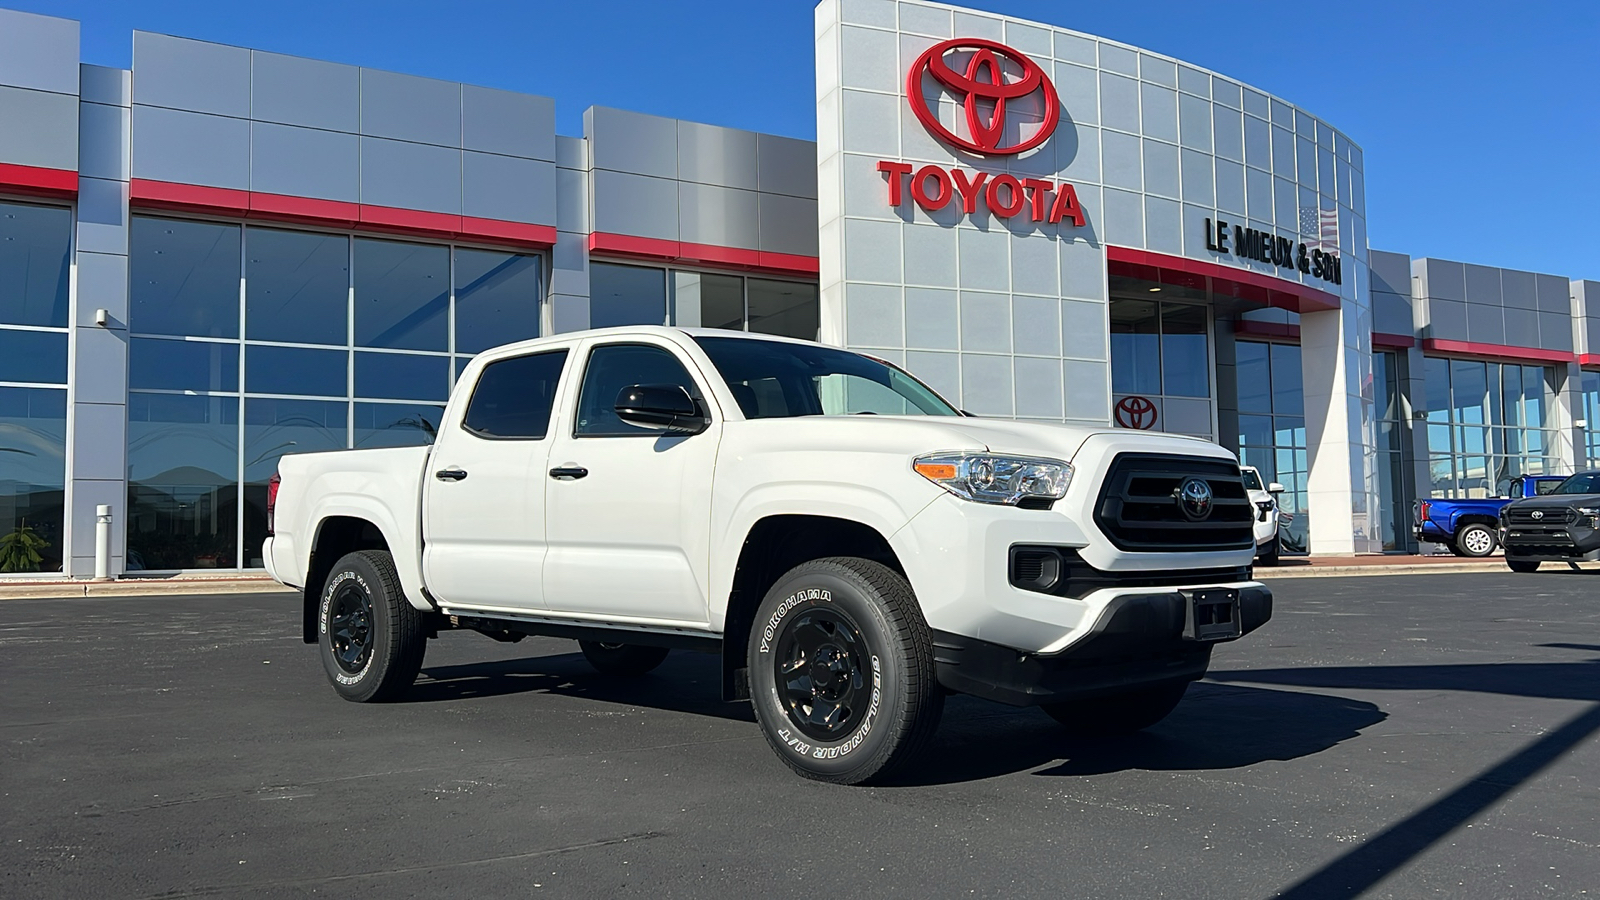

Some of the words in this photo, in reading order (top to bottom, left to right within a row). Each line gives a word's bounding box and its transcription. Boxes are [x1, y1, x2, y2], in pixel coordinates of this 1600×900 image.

[876, 160, 1086, 227] TOYOTA
[1205, 217, 1229, 254] LE
[1235, 224, 1294, 270] MIEUX
[1297, 242, 1311, 275] &
[1311, 248, 1342, 286] SON
[760, 588, 832, 654] YOKOHAMA
[813, 655, 882, 759] GEOLANDAR
[778, 728, 811, 755] H/T
